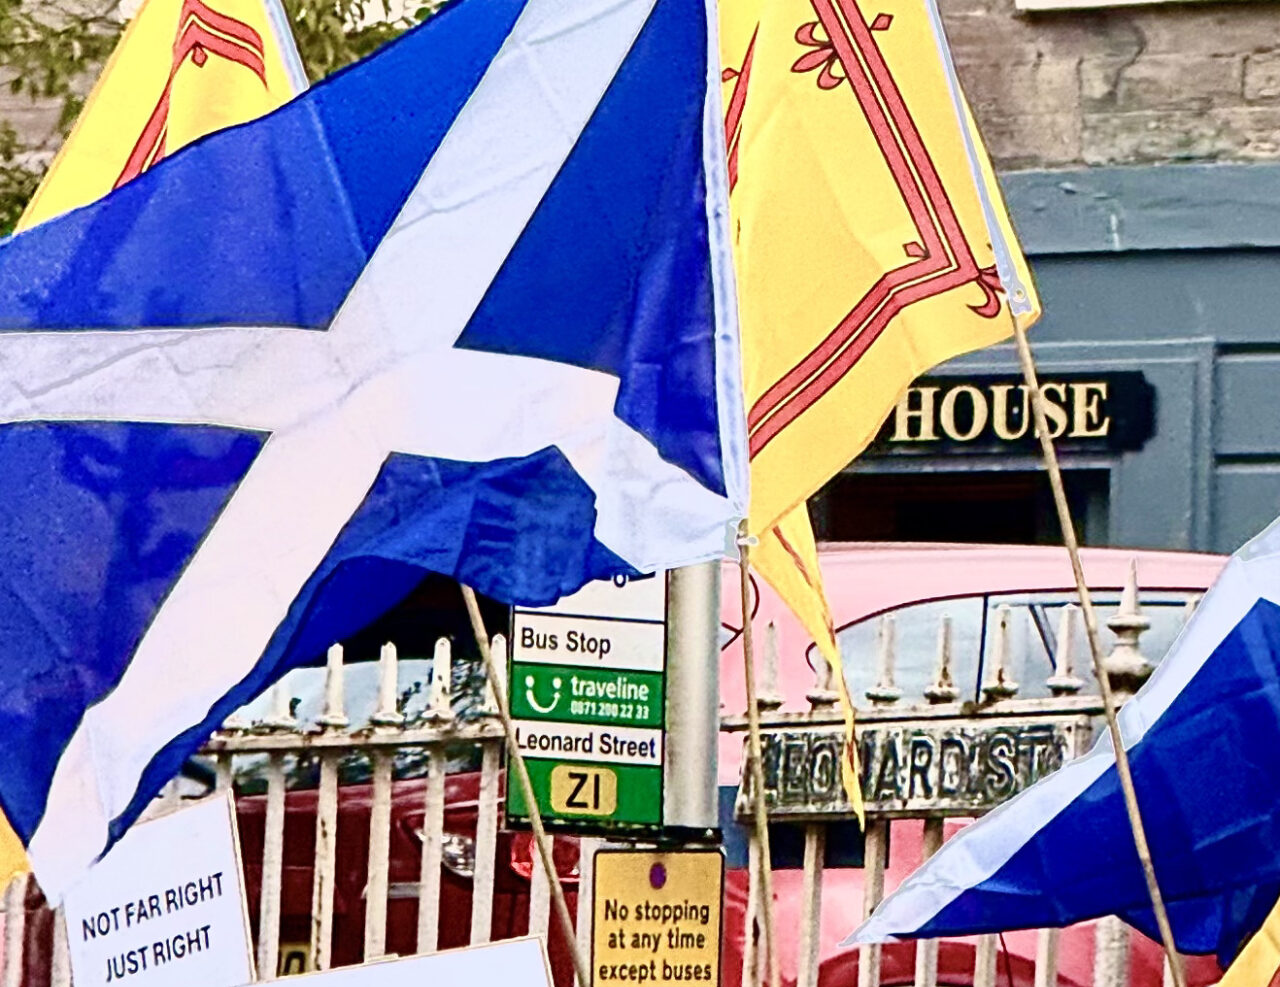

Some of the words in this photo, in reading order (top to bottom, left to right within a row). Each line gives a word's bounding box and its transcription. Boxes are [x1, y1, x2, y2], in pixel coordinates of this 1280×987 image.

[890, 382, 1110, 441] HOUSE
[521, 627, 558, 650] Bus
[566, 630, 611, 659] Stop
[571, 676, 649, 701] traveline
[620, 704, 633, 718] 22
[636, 705, 649, 719] 33
[516, 727, 593, 753] Leonard
[600, 731, 656, 758] Street
[757, 734, 968, 800] LEOARD
[82, 908, 120, 941] NOT
[125, 895, 162, 928] FAR
[166, 872, 223, 914] RIGHT
[605, 900, 628, 920] No
[635, 900, 709, 925] stopping
[106, 946, 148, 982] JUST
[153, 925, 211, 966] RIGHT
[608, 929, 625, 949] at
[631, 933, 661, 952] any
[667, 927, 705, 949] time
[599, 960, 656, 984] except
[662, 960, 712, 981] buses
